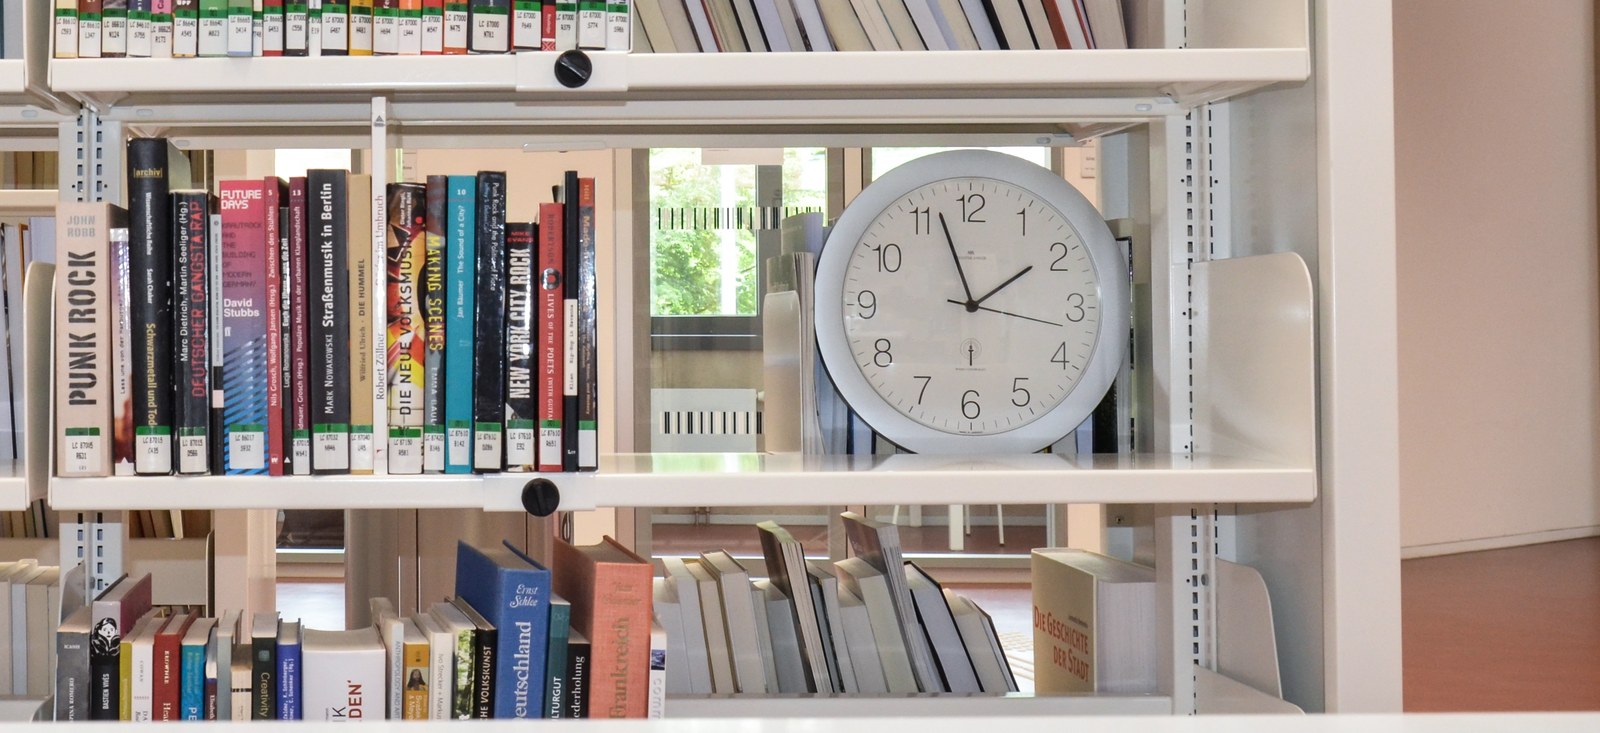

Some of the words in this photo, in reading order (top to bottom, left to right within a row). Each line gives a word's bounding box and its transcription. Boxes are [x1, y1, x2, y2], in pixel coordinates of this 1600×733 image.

[221, 190, 262, 199] FUTURE
[221, 200, 249, 209] DAYS
[321, 183, 332, 220] Berlin
[956, 194, 986, 222] 12
[67, 216, 96, 225] JOHN
[178, 202, 189, 225] (Hg.)
[191, 200, 205, 231] RAP
[375, 195, 384, 238] Umbruch
[490, 216, 499, 228] and
[910, 206, 930, 235] 11
[1017, 207, 1026, 236] 1
[67, 227, 96, 237] ROBB
[178, 226, 189, 263] Seeliger
[294, 206, 302, 255] Klanglandschaft
[322, 224, 332, 237] in
[457, 229, 464, 237] of
[491, 230, 499, 241] the
[457, 239, 465, 259] Sound
[872, 243, 902, 272] 10
[1050, 242, 1068, 271] 2
[191, 235, 205, 302] GANGSTA
[357, 259, 365, 298] HUMMEL
[427, 237, 442, 291] MAKING
[509, 248, 530, 285] ROCK
[68, 251, 96, 324] ROCK
[179, 268, 188, 295] Martin
[268, 284, 277, 308] (Hrsg.)
[322, 240, 334, 327] Straßenmusik
[456, 280, 465, 303] Bäumer
[179, 297, 189, 336] Dietrich,
[224, 298, 252, 307] David
[224, 308, 259, 317] Stubbs
[456, 305, 464, 317] Jan
[509, 289, 530, 320] CITY
[547, 293, 555, 318] LIVES
[858, 290, 876, 319] 9
[1066, 293, 1085, 322] 3
[269, 309, 277, 331] Jansen
[428, 299, 443, 351] SCENES
[547, 321, 554, 330] OF
[179, 338, 188, 362] Marc
[270, 333, 278, 364] Wolfgang
[358, 326, 366, 350] Ulrich
[375, 333, 384, 365] Zöllner
[509, 326, 530, 361] YORK
[874, 338, 893, 367] 8
[146, 323, 157, 388] Schwarzmetall
[191, 310, 206, 397] DEUTSCHER
[324, 334, 334, 387] NOWAKOWSKI
[358, 351, 366, 382] Wilfried
[400, 342, 412, 384] NEUE
[547, 348, 555, 374] POETS
[1051, 341, 1070, 370] 4
[69, 333, 97, 406] PUNK
[376, 367, 384, 400] Robert
[509, 366, 530, 398] NEW
[147, 389, 156, 407] und
[547, 377, 555, 396] (WITH
[913, 376, 932, 404] 7
[1012, 377, 1030, 407] 5
[325, 390, 334, 414] MARK
[400, 390, 412, 415] DIE
[962, 390, 981, 419] 6
[148, 408, 158, 426] Tod
[510, 596, 538, 608] Schlee
[516, 583, 538, 595] Ernst
[1035, 606, 1046, 633] DIE
[1047, 612, 1088, 655] GESCHICHTE
[481, 646, 492, 703] VOLKSKUNST
[609, 617, 629, 720] Frankreich
[1068, 649, 1089, 683] STADT
[260, 672, 270, 717] Creativity
[551, 677, 562, 720] LTURGUT
